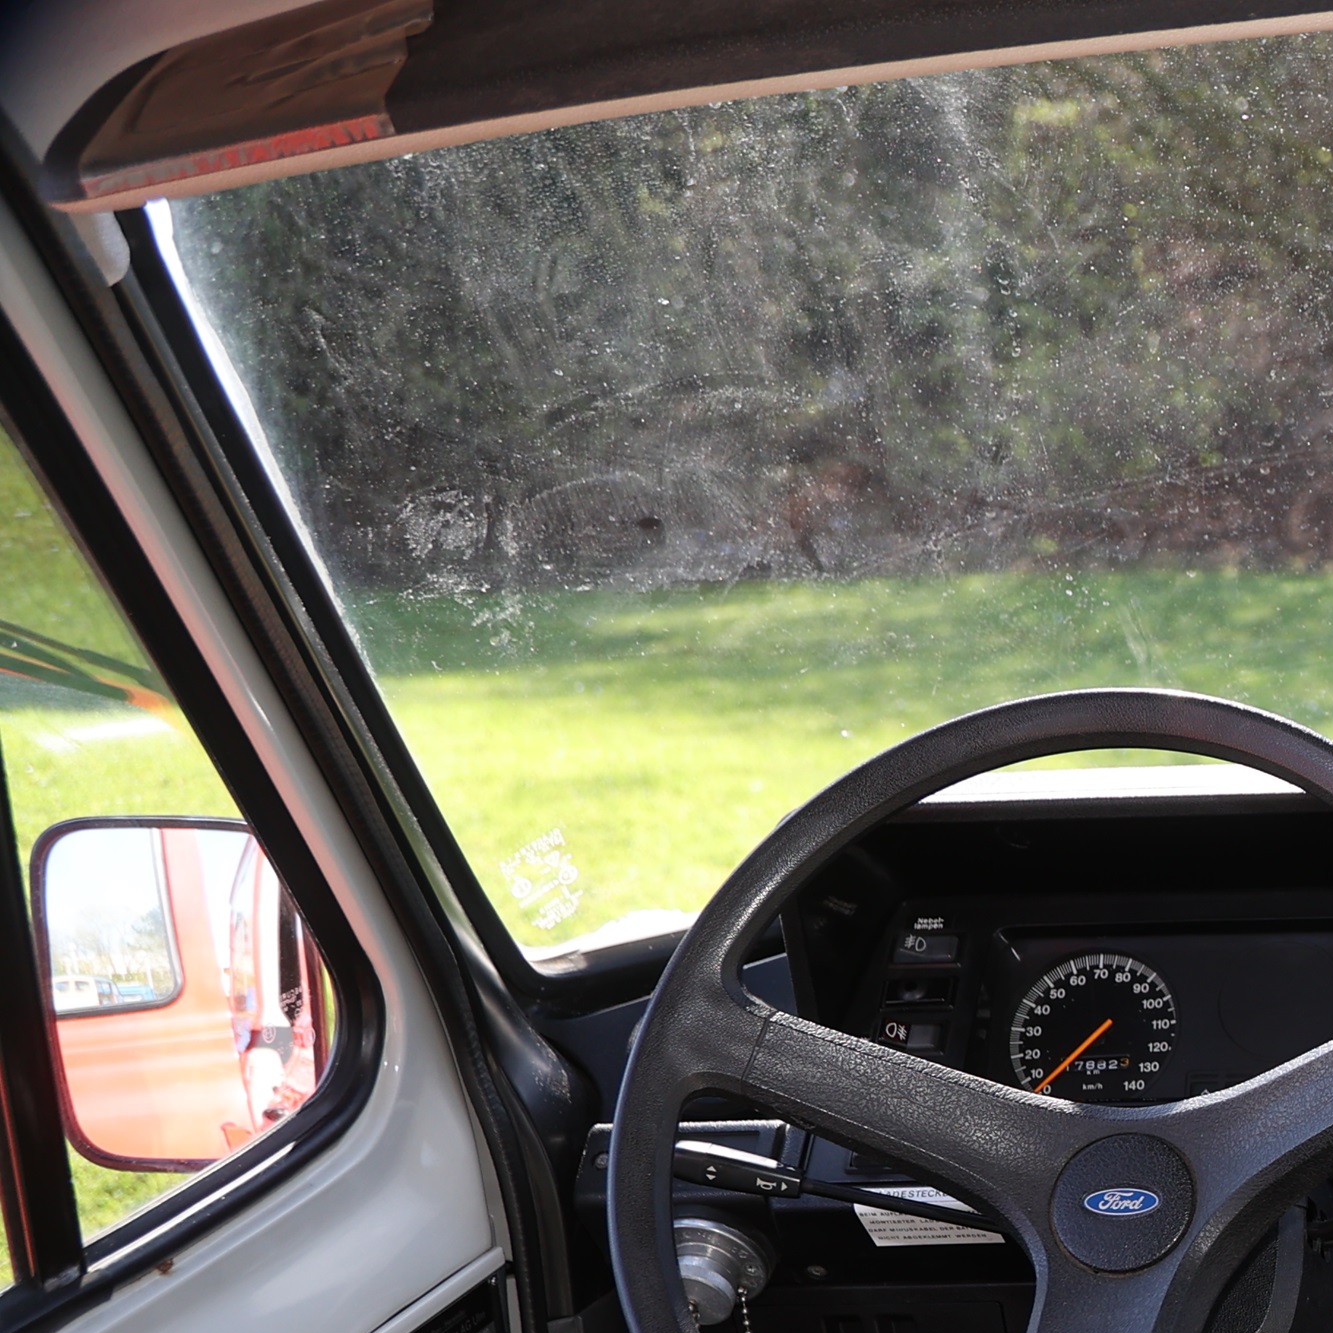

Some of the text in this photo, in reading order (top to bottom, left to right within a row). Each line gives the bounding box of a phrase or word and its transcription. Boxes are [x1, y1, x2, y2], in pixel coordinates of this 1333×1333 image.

[1093, 969, 1109, 979] 70
[1115, 972, 1131, 983] 80
[1070, 976, 1086, 986] 60
[1049, 988, 1066, 999] 50
[1133, 983, 1150, 994] 90
[1142, 999, 1163, 1009] 100
[1034, 1005, 1050, 1015] 40
[1152, 1019, 1170, 1030] 110
[1026, 1026, 1042, 1036] 30
[1148, 1042, 1169, 1053] 120
[1025, 1049, 1041, 1060] 20
[1139, 1062, 1160, 1072] 130
[1030, 1069, 1044, 1078] 10
[1043, 1085, 1051, 1095] 0
[1123, 1080, 1145, 1091] 140
[1099, 1192, 1145, 1210] Ford
